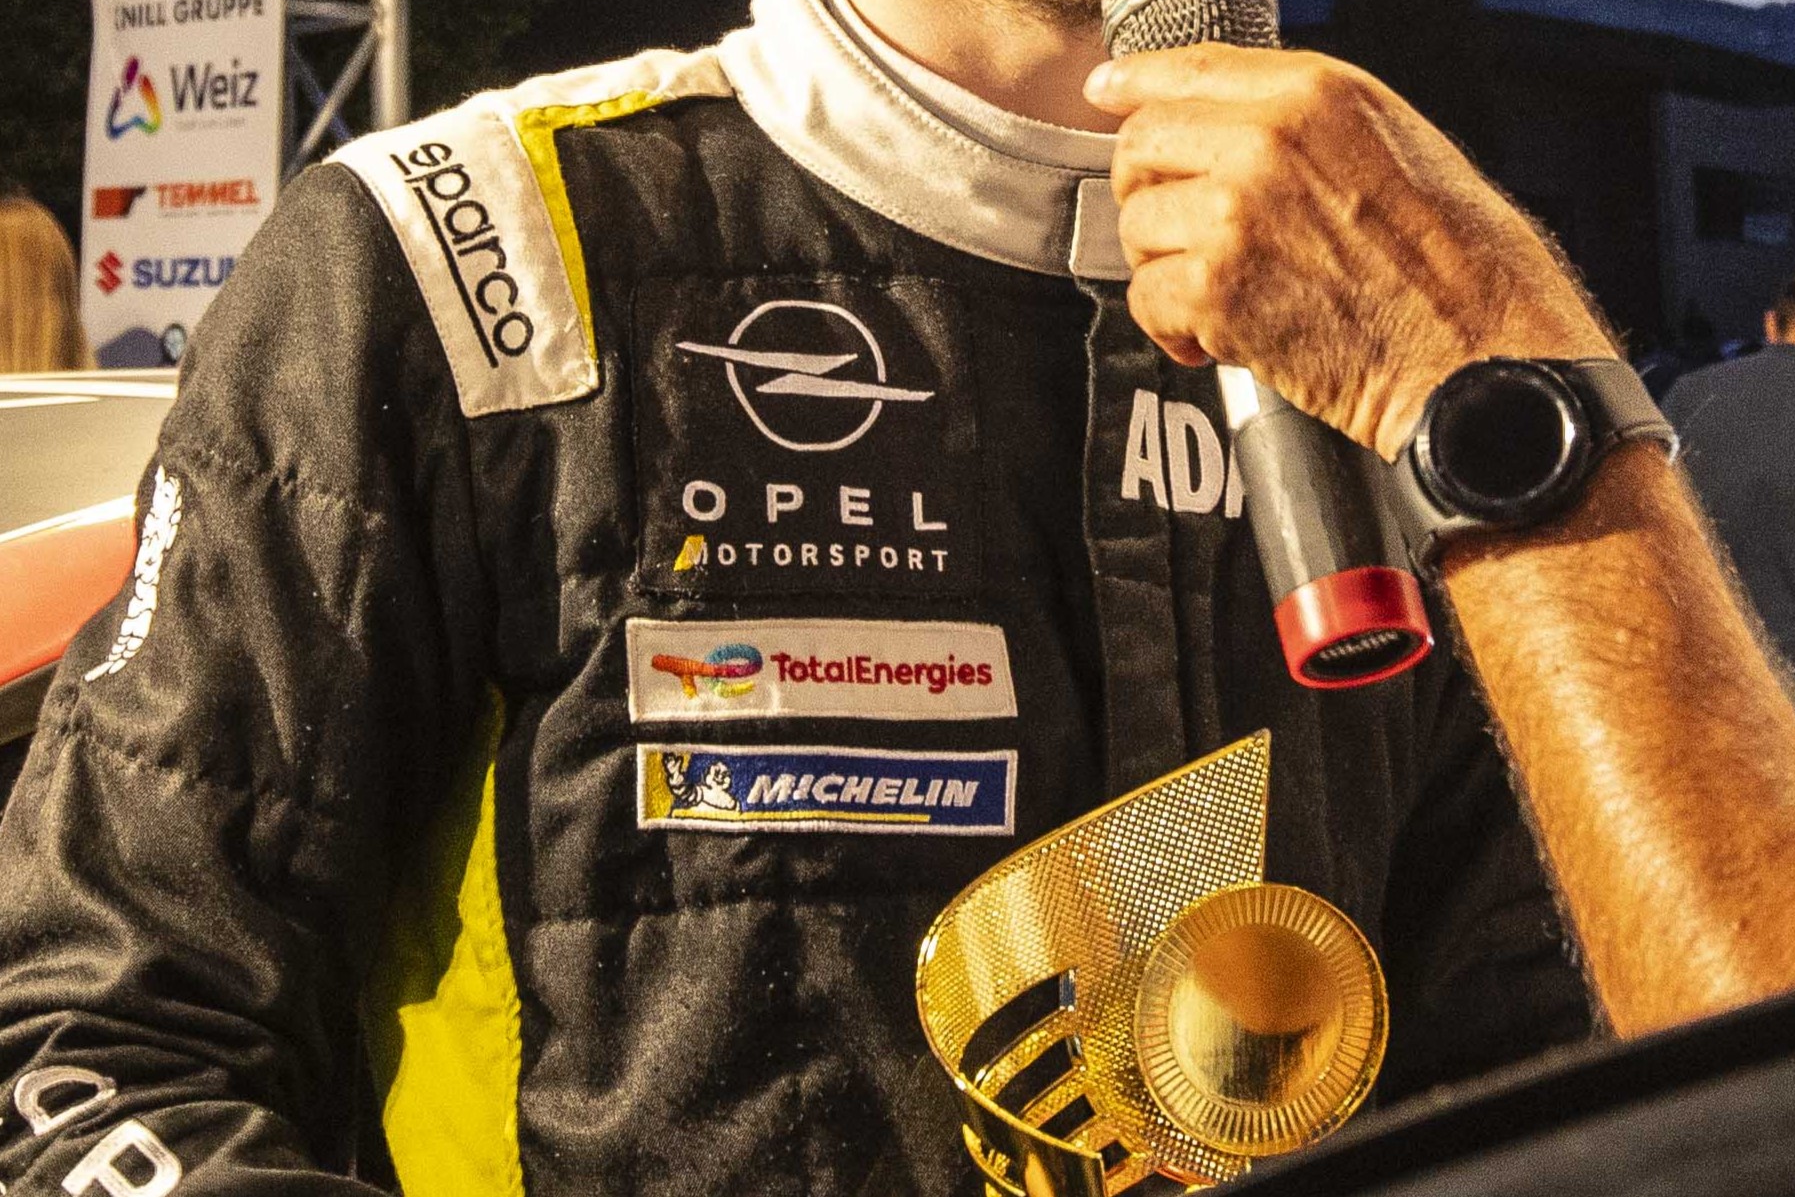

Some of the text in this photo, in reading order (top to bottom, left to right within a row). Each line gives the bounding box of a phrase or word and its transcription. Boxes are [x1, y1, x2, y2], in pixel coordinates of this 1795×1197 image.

[169, 58, 259, 113] Weiz
[402, 142, 535, 358] sparco
[132, 256, 236, 289] SUZU
[682, 480, 948, 532] OPEL
[682, 541, 949, 573] MOTORSPORT
[769, 651, 993, 695] TotalEnergies
[747, 772, 980, 808] MICHELIN
